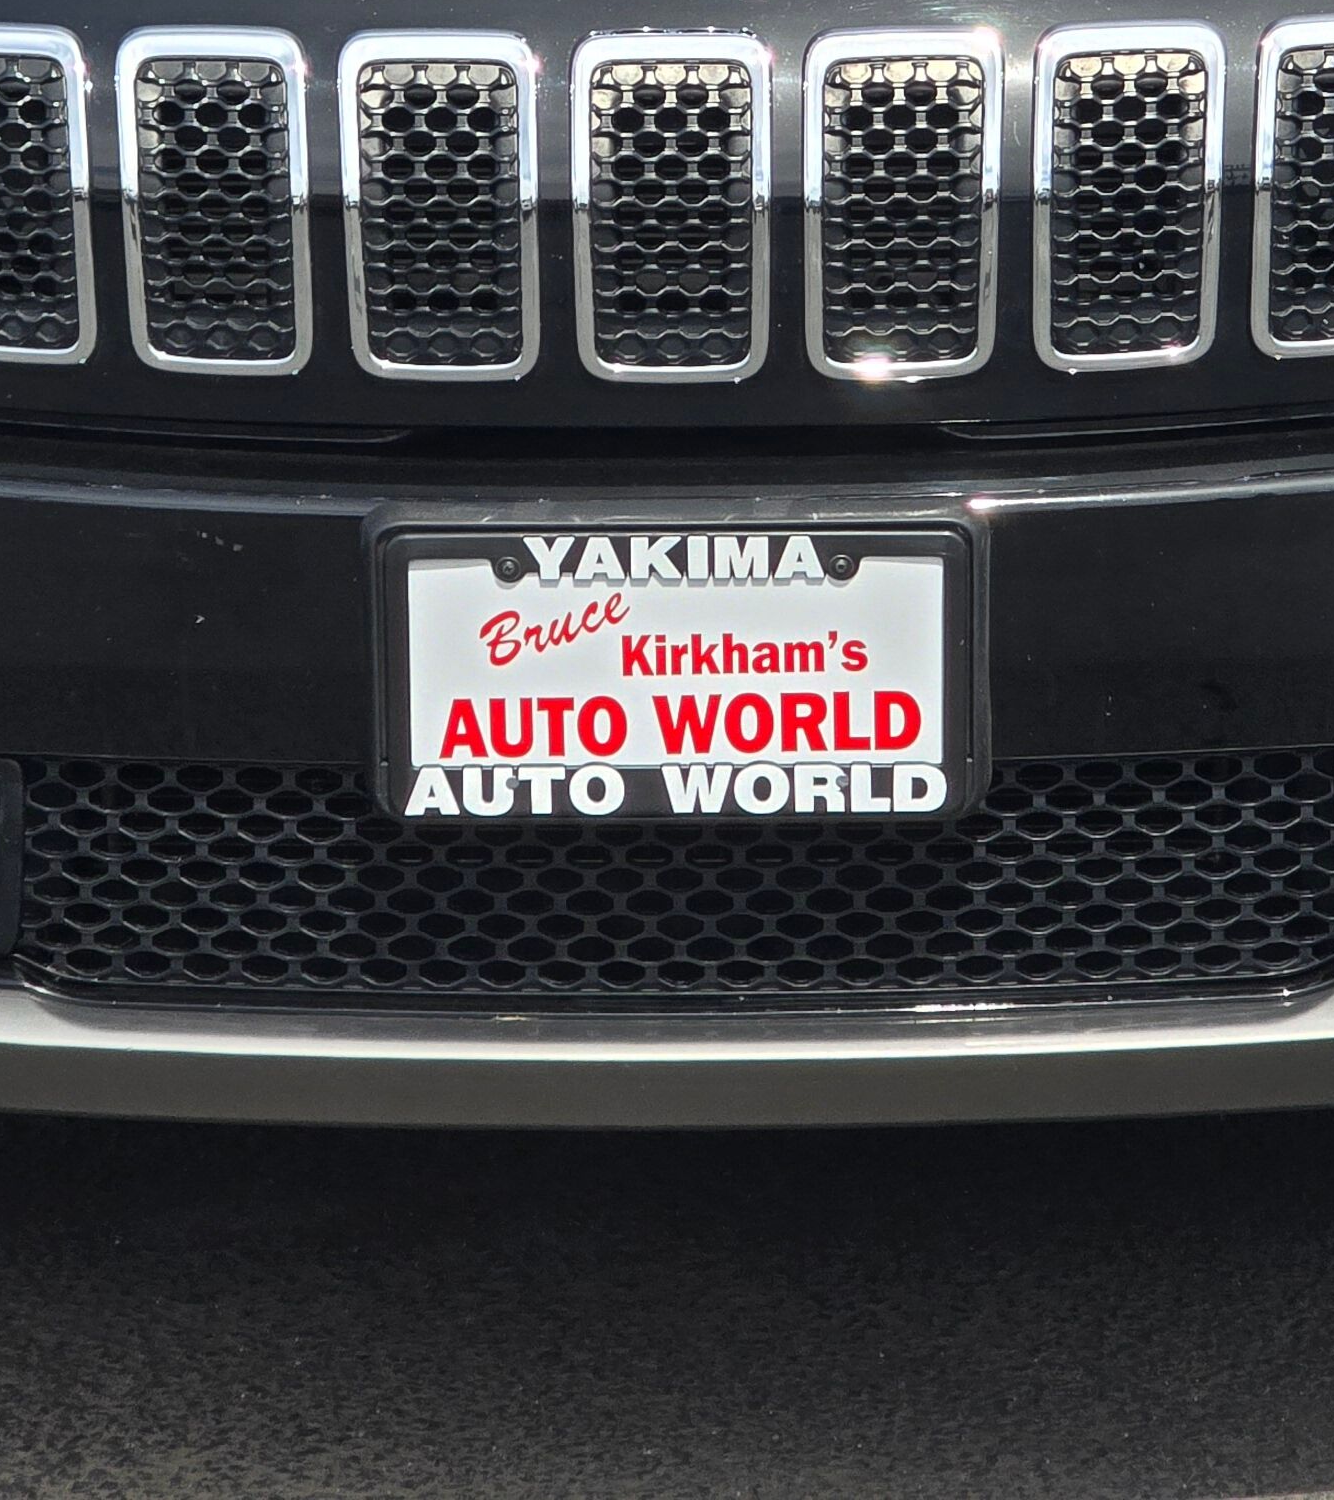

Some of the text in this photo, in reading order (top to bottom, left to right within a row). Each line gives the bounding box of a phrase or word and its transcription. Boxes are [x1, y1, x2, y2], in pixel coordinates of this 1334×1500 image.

[523, 535, 825, 581] YAKIMA
[479, 593, 869, 676] Bruce Kirkham's
[439, 691, 922, 759] AUTO WORLD
[404, 763, 948, 816] AUTO WORLD
